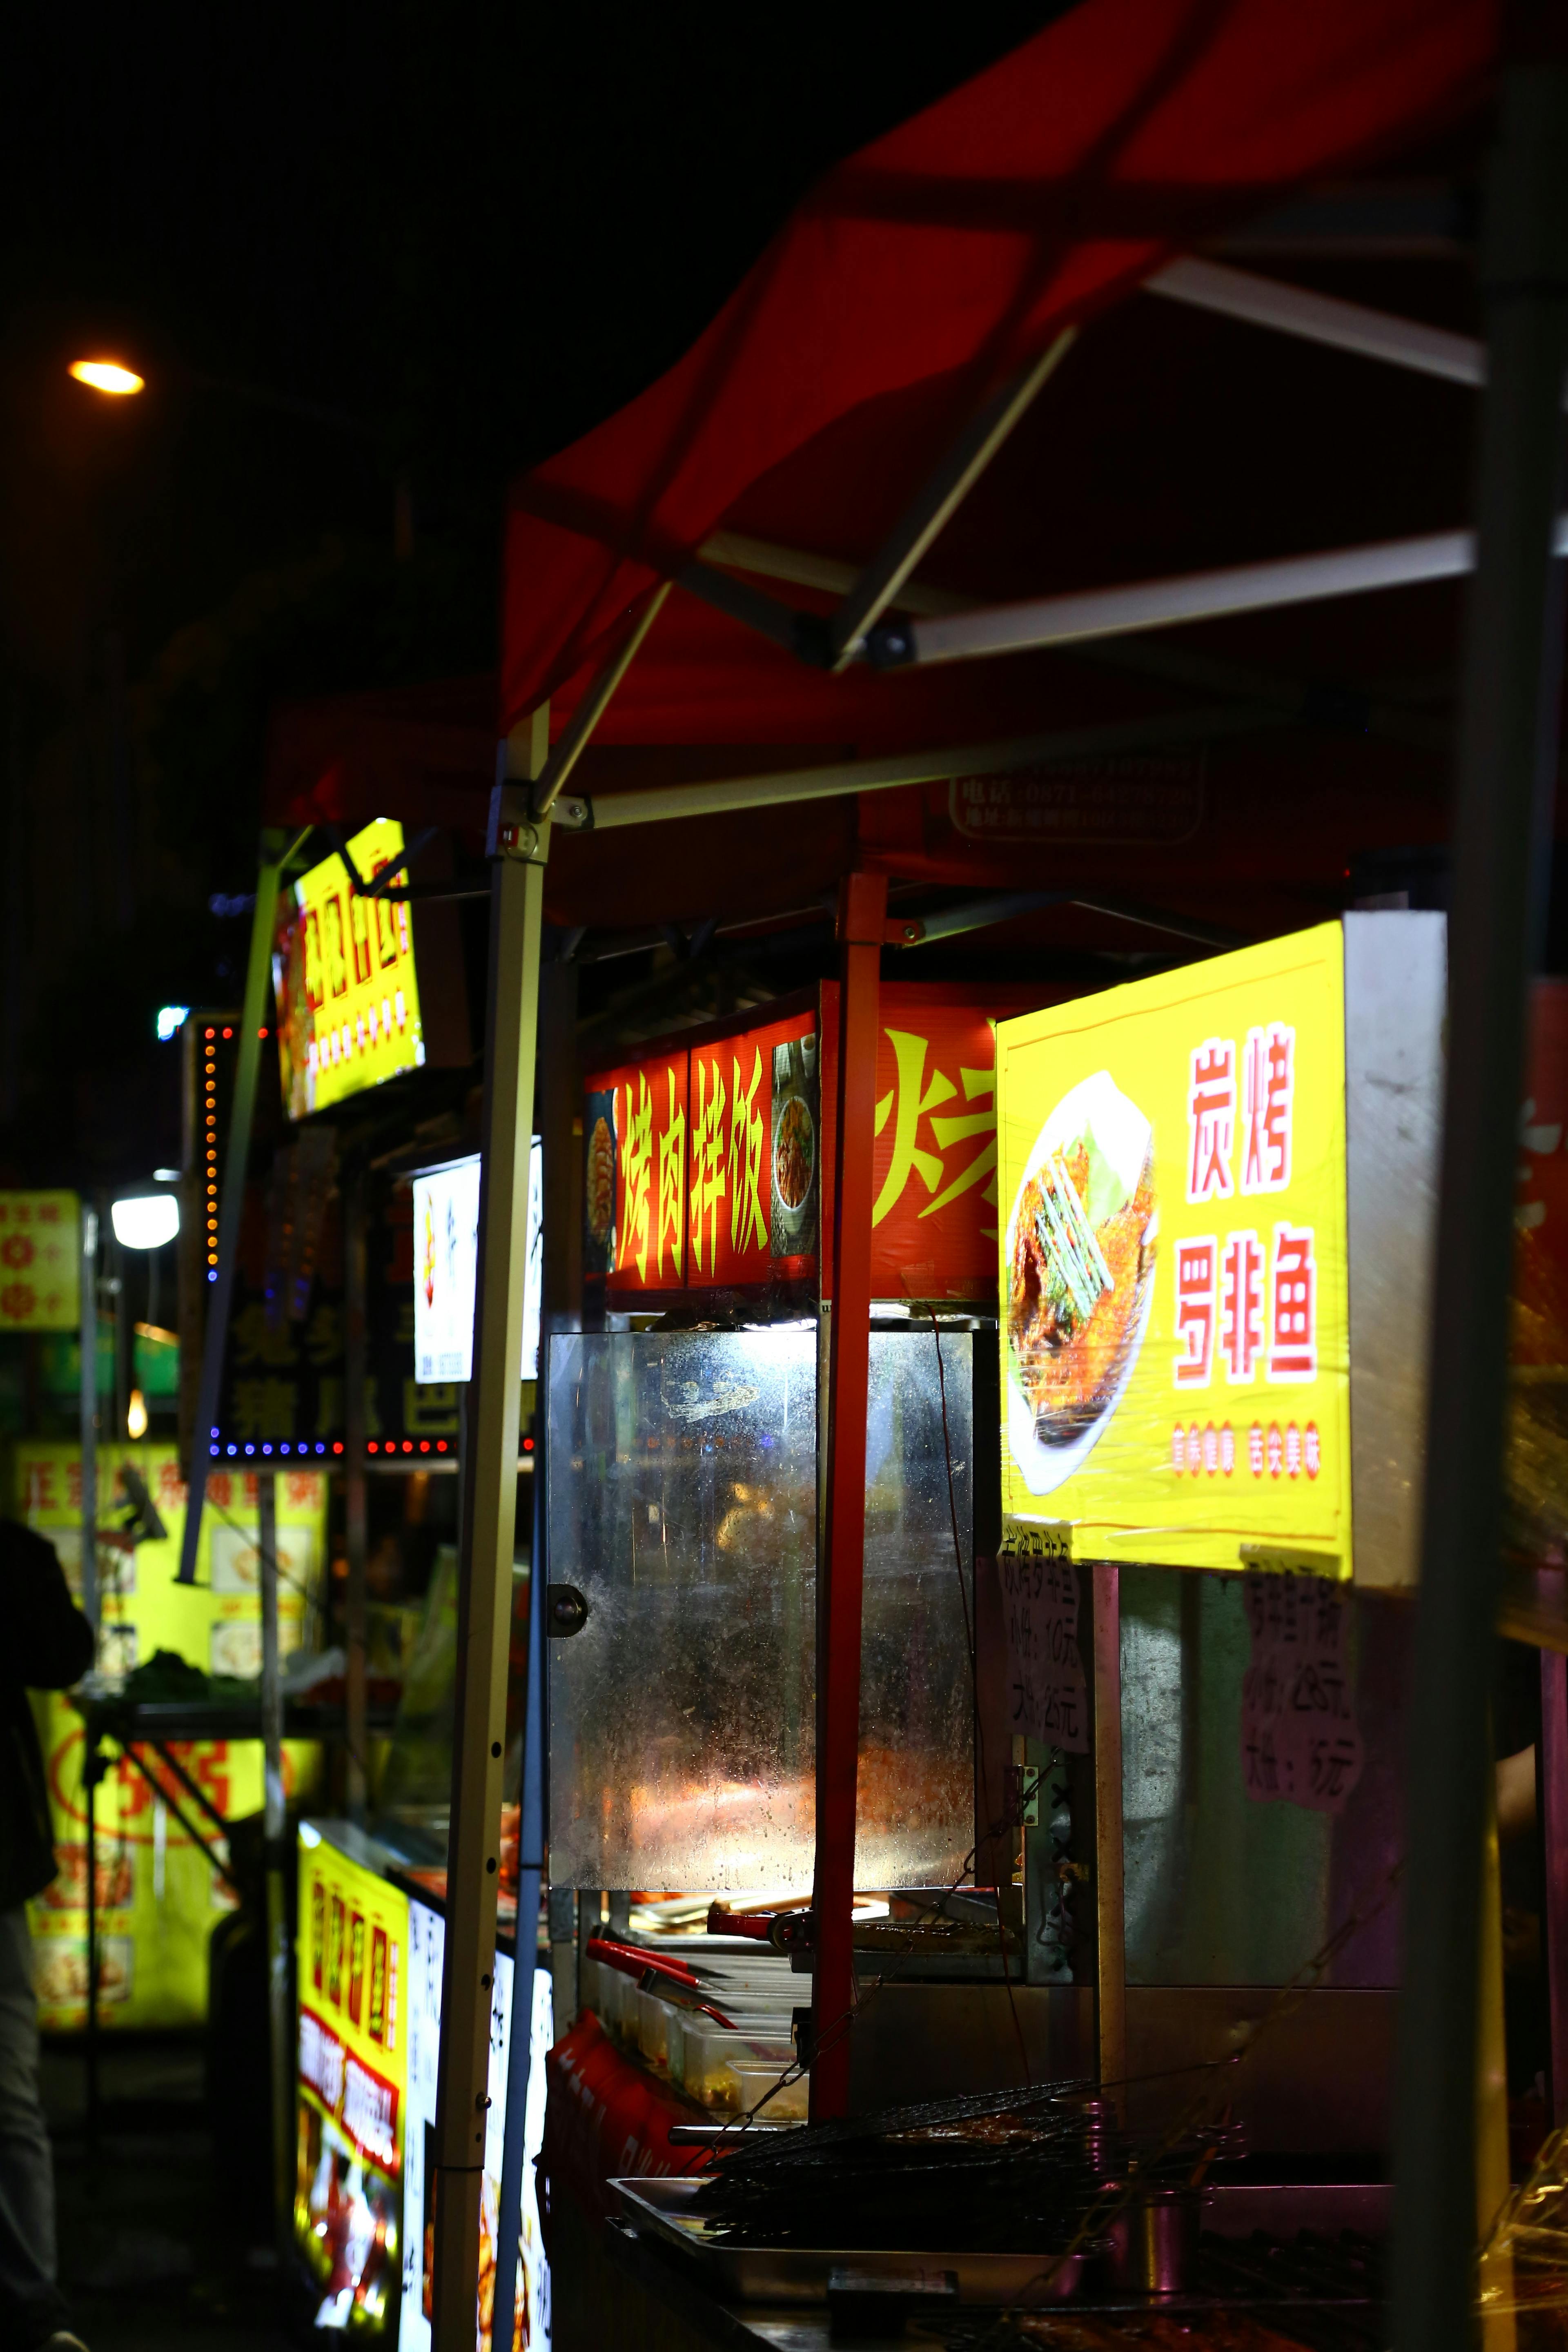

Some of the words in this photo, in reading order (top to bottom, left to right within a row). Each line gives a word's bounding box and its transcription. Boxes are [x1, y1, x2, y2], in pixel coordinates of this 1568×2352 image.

[619, 1045, 769, 1283] 烤肉拌饭
[1190, 1029, 1292, 1196] 炭烤
[1175, 1231, 1314, 1384] 罗非鱼
[1250, 1425, 1320, 1474] 舌尖美味
[1002, 1524, 1076, 1606] 炭烤罗非鱼
